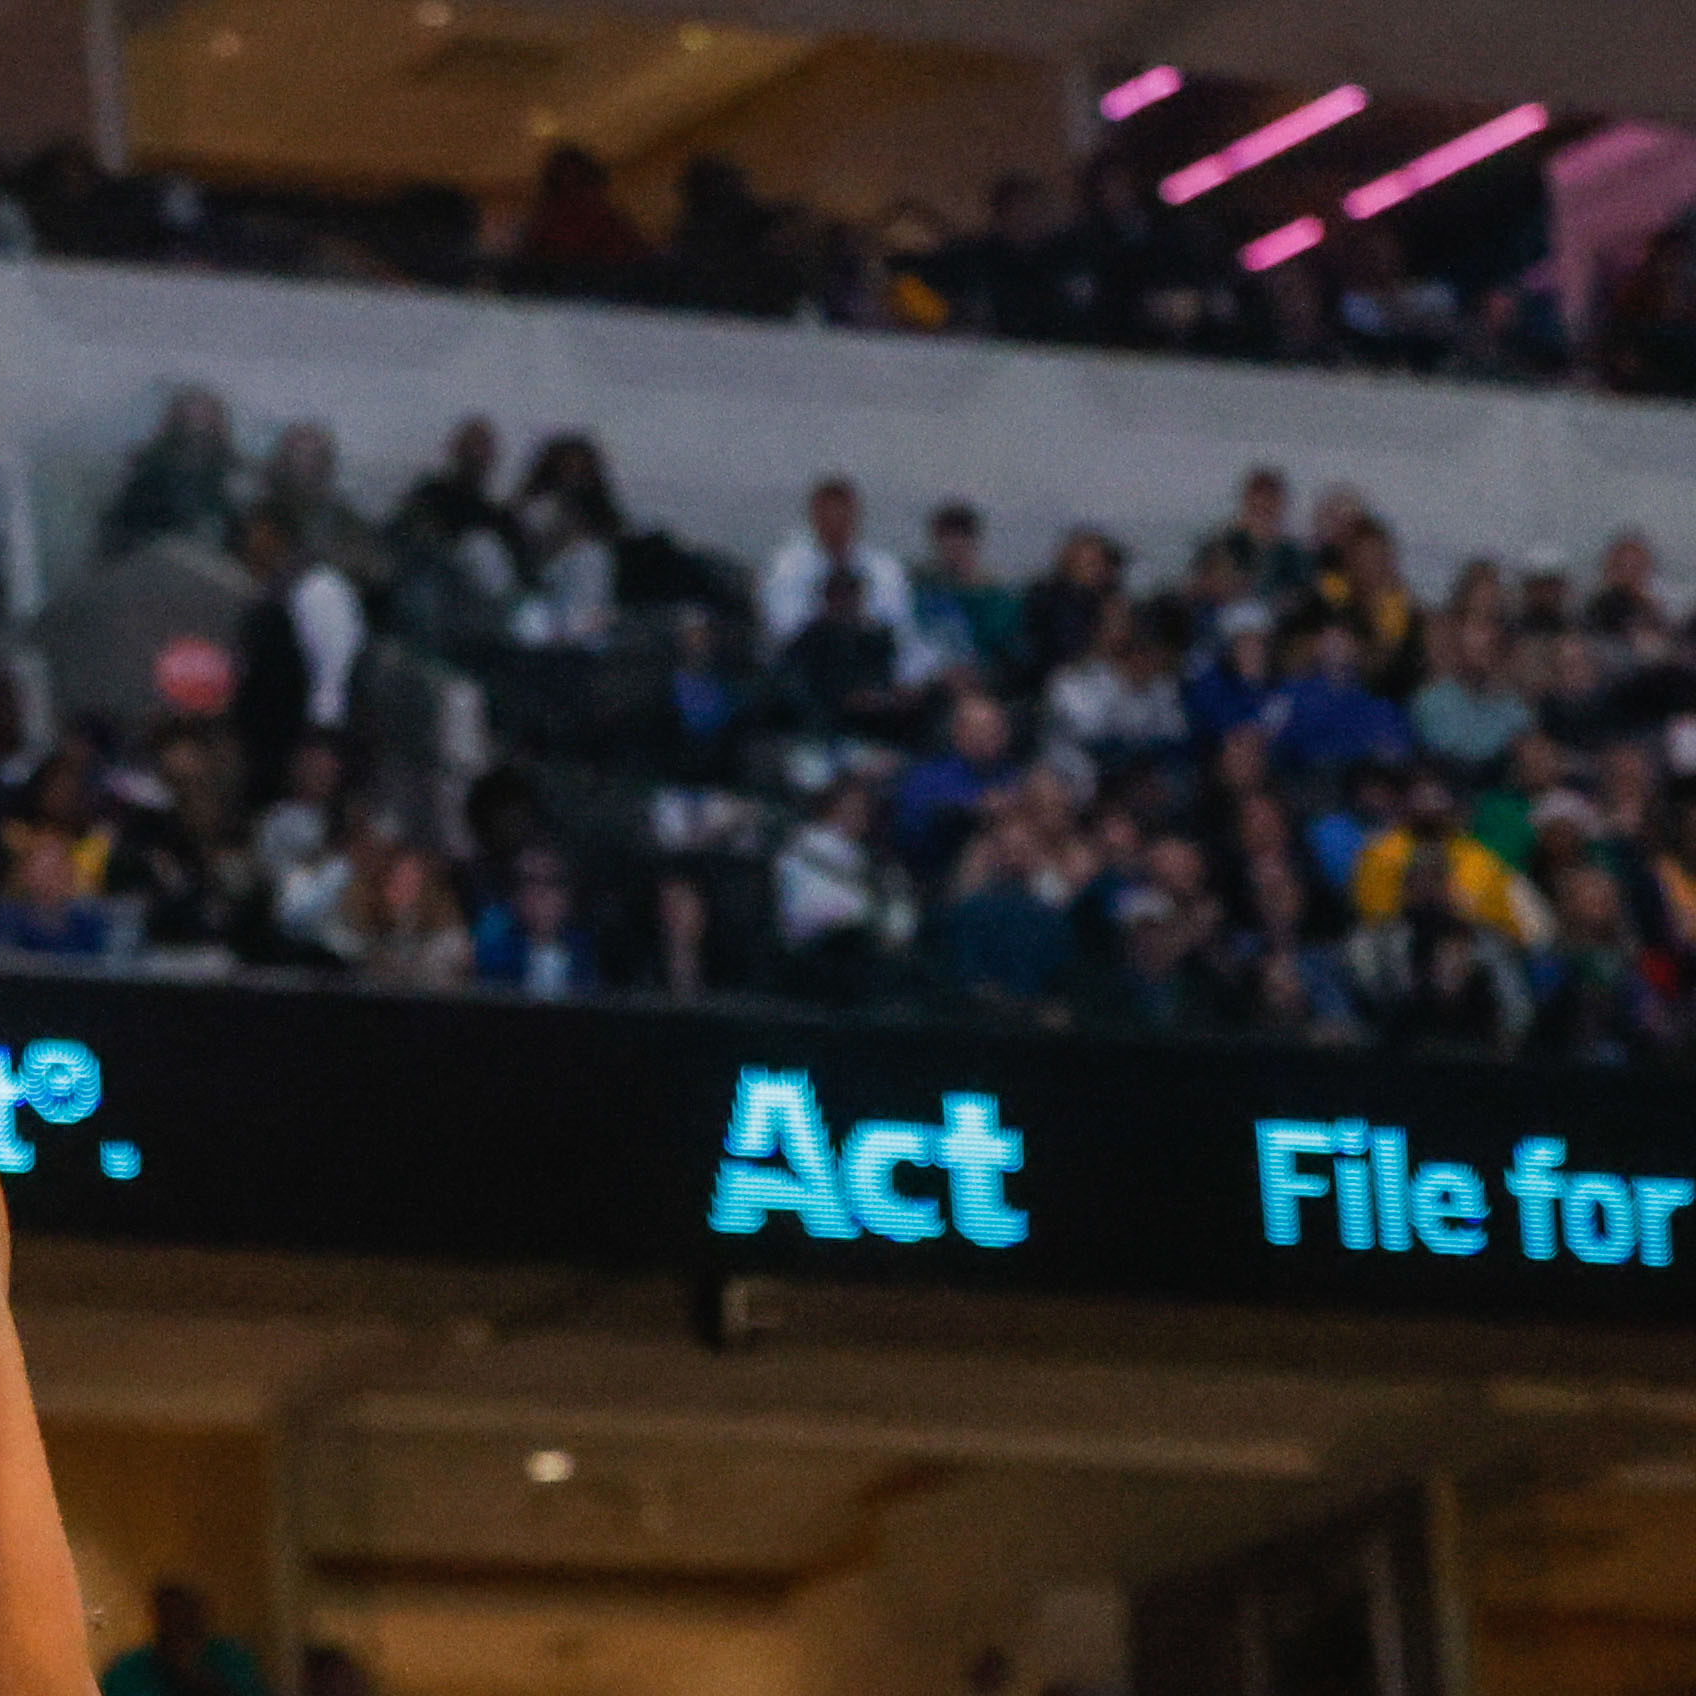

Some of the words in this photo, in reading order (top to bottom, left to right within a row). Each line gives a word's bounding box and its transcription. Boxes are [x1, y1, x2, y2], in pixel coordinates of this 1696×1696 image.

[708, 1065, 1029, 1247] Act
[1255, 1117, 1490, 1256] File
[1504, 1136, 1695, 1267] for
